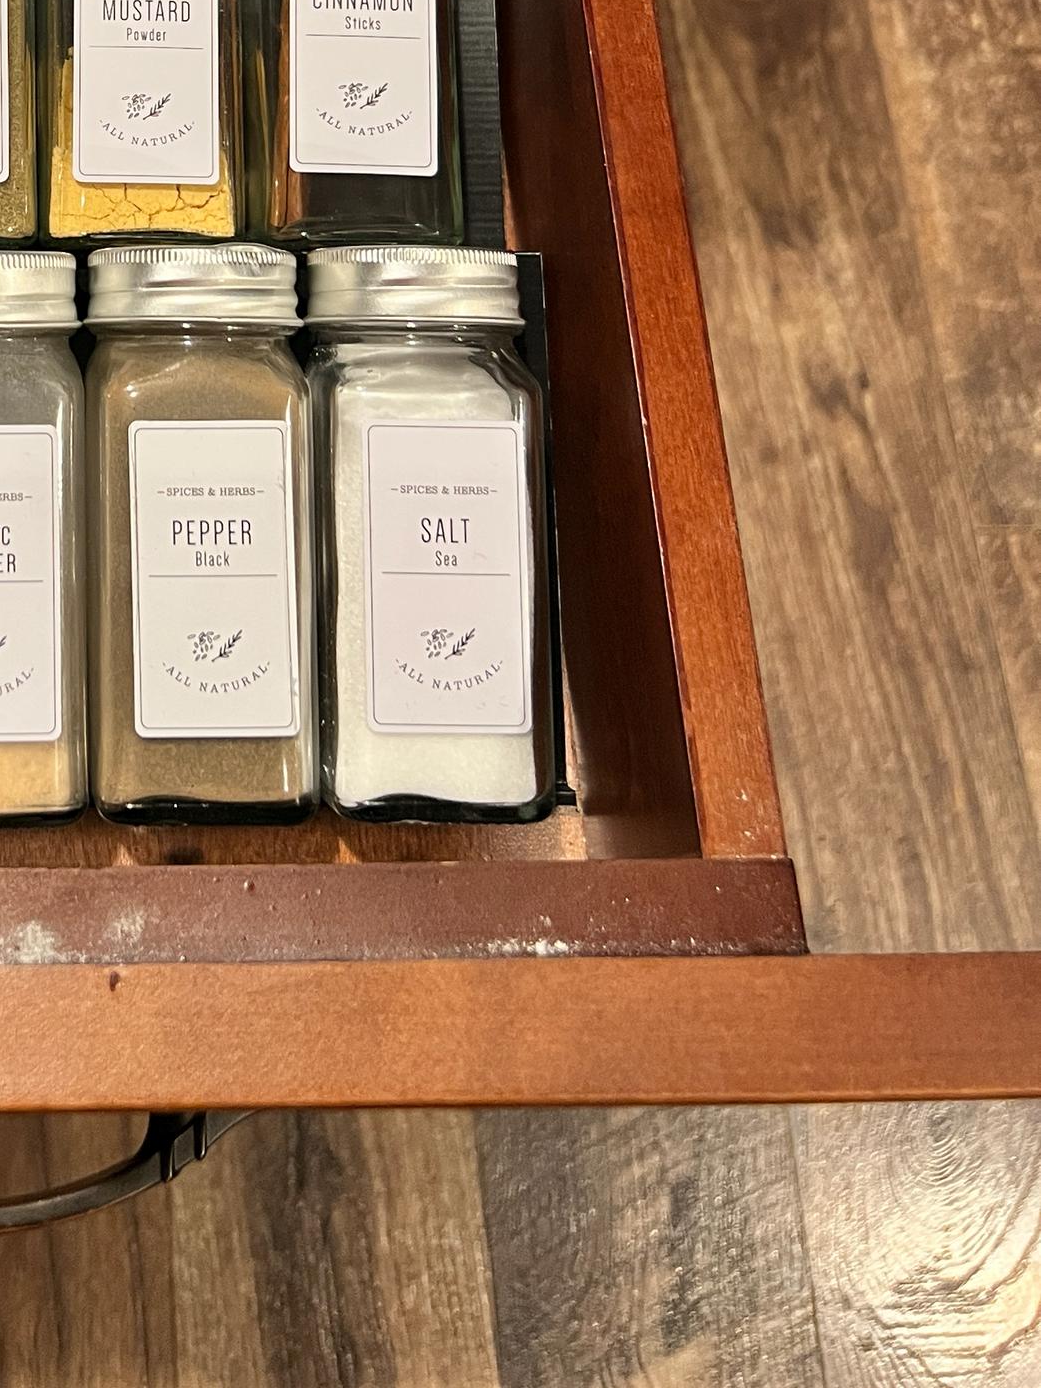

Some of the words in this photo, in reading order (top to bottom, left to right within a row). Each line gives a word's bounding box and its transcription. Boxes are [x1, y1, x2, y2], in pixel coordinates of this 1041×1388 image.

[103, 0, 190, 22] MUSTARD
[345, 16, 381, 30] Sticks
[126, 28, 166, 41] Powder
[173, 520, 252, 546] PEPPER
[421, 518, 469, 543] SALT
[196, 551, 230, 567] Black
[435, 551, 457, 566] Sea
